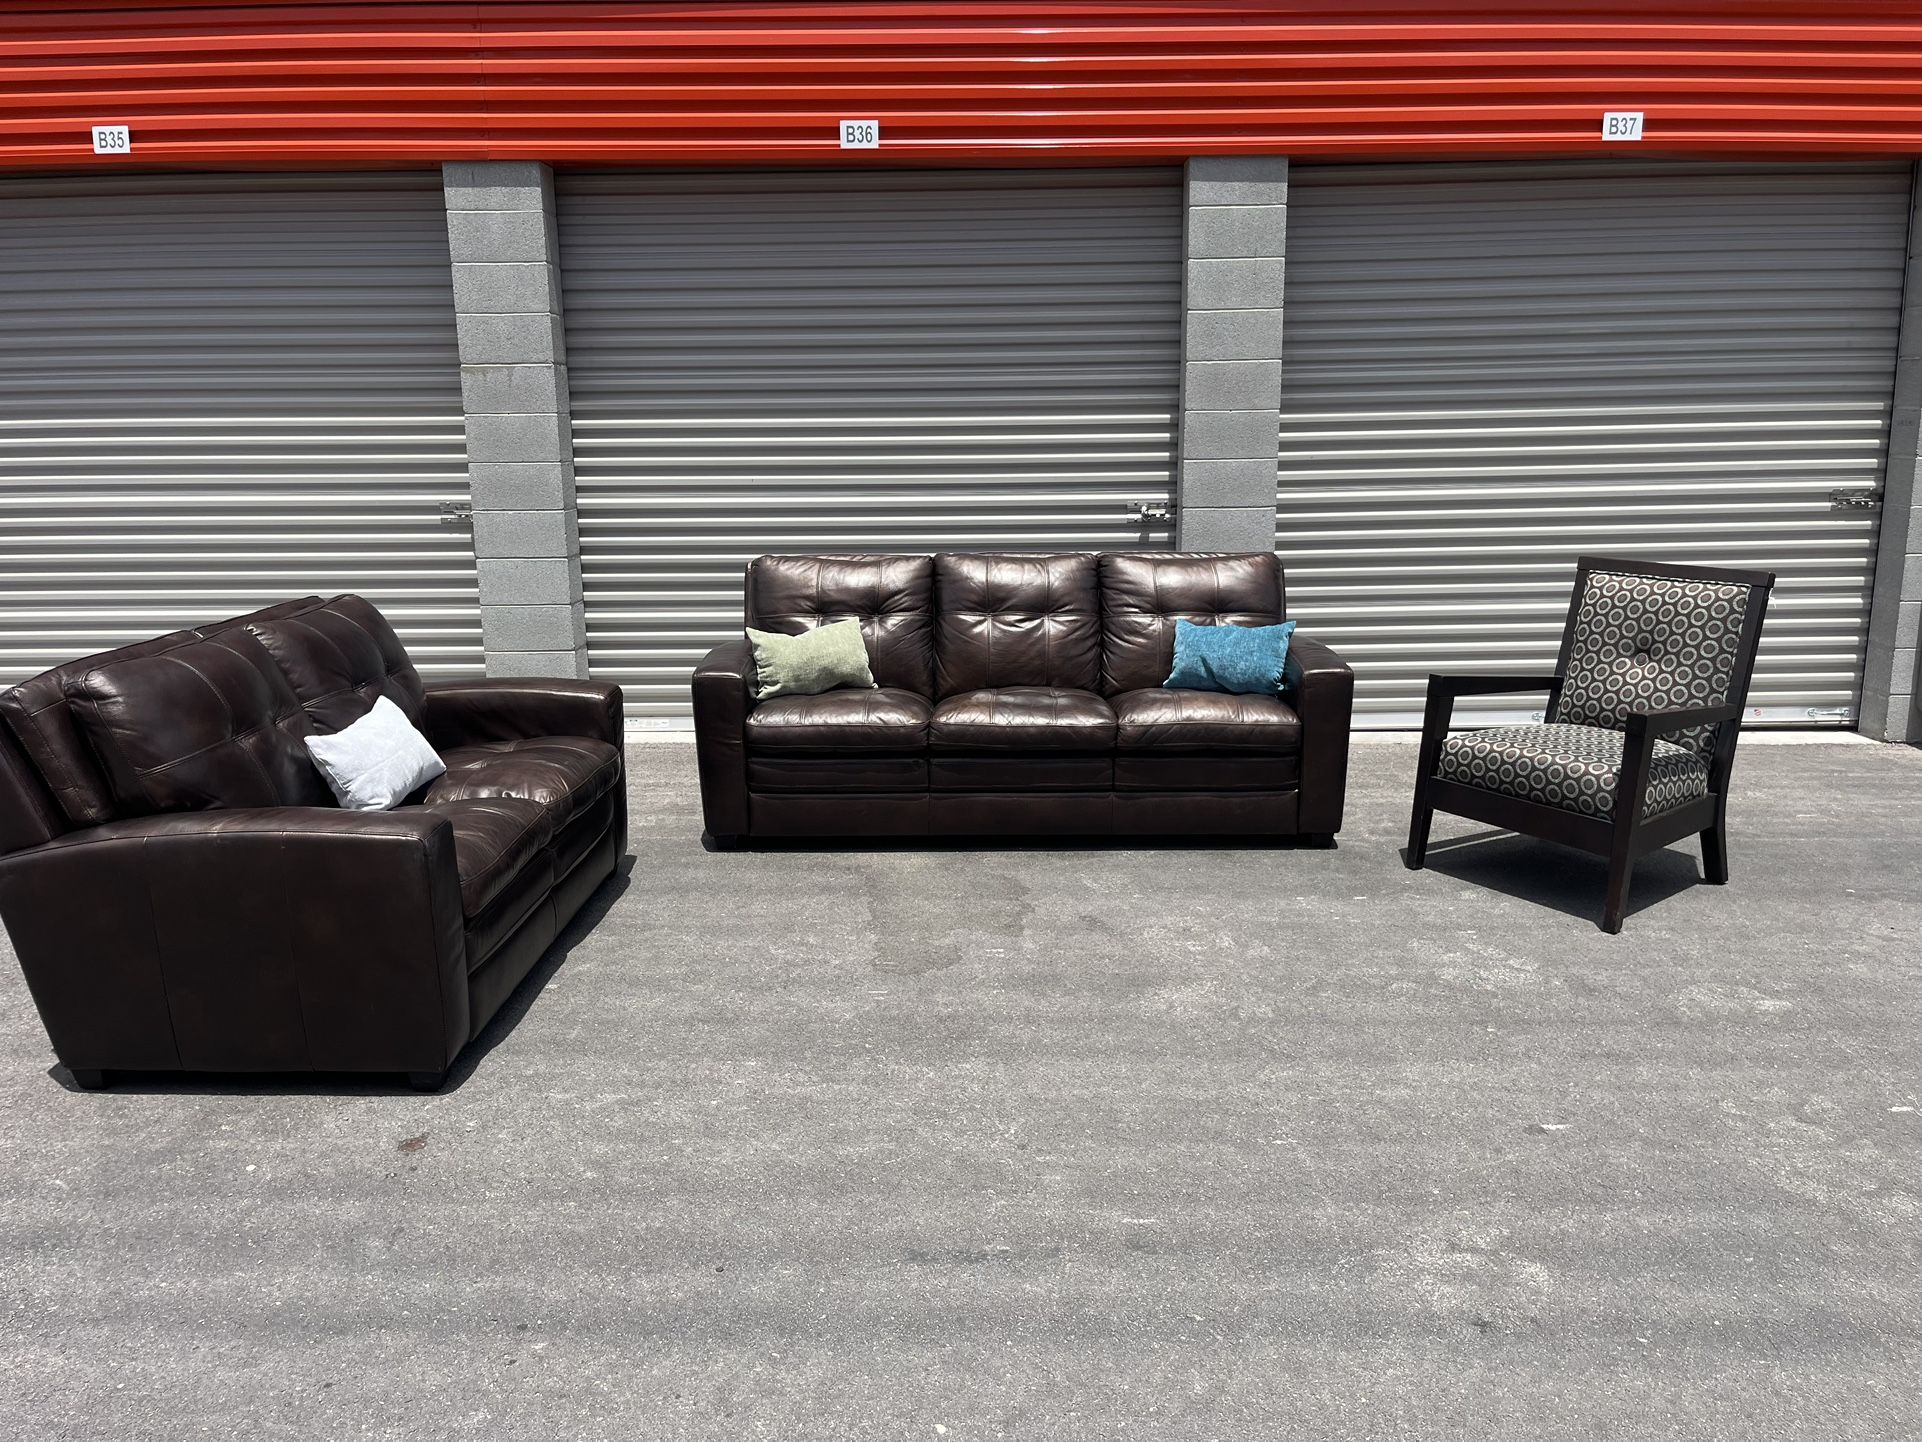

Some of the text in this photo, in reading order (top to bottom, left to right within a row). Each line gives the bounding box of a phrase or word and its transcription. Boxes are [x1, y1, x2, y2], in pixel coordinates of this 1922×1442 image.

[846, 125, 873, 143] B36
[1609, 117, 1637, 135] B37
[98, 131, 125, 148] B35
